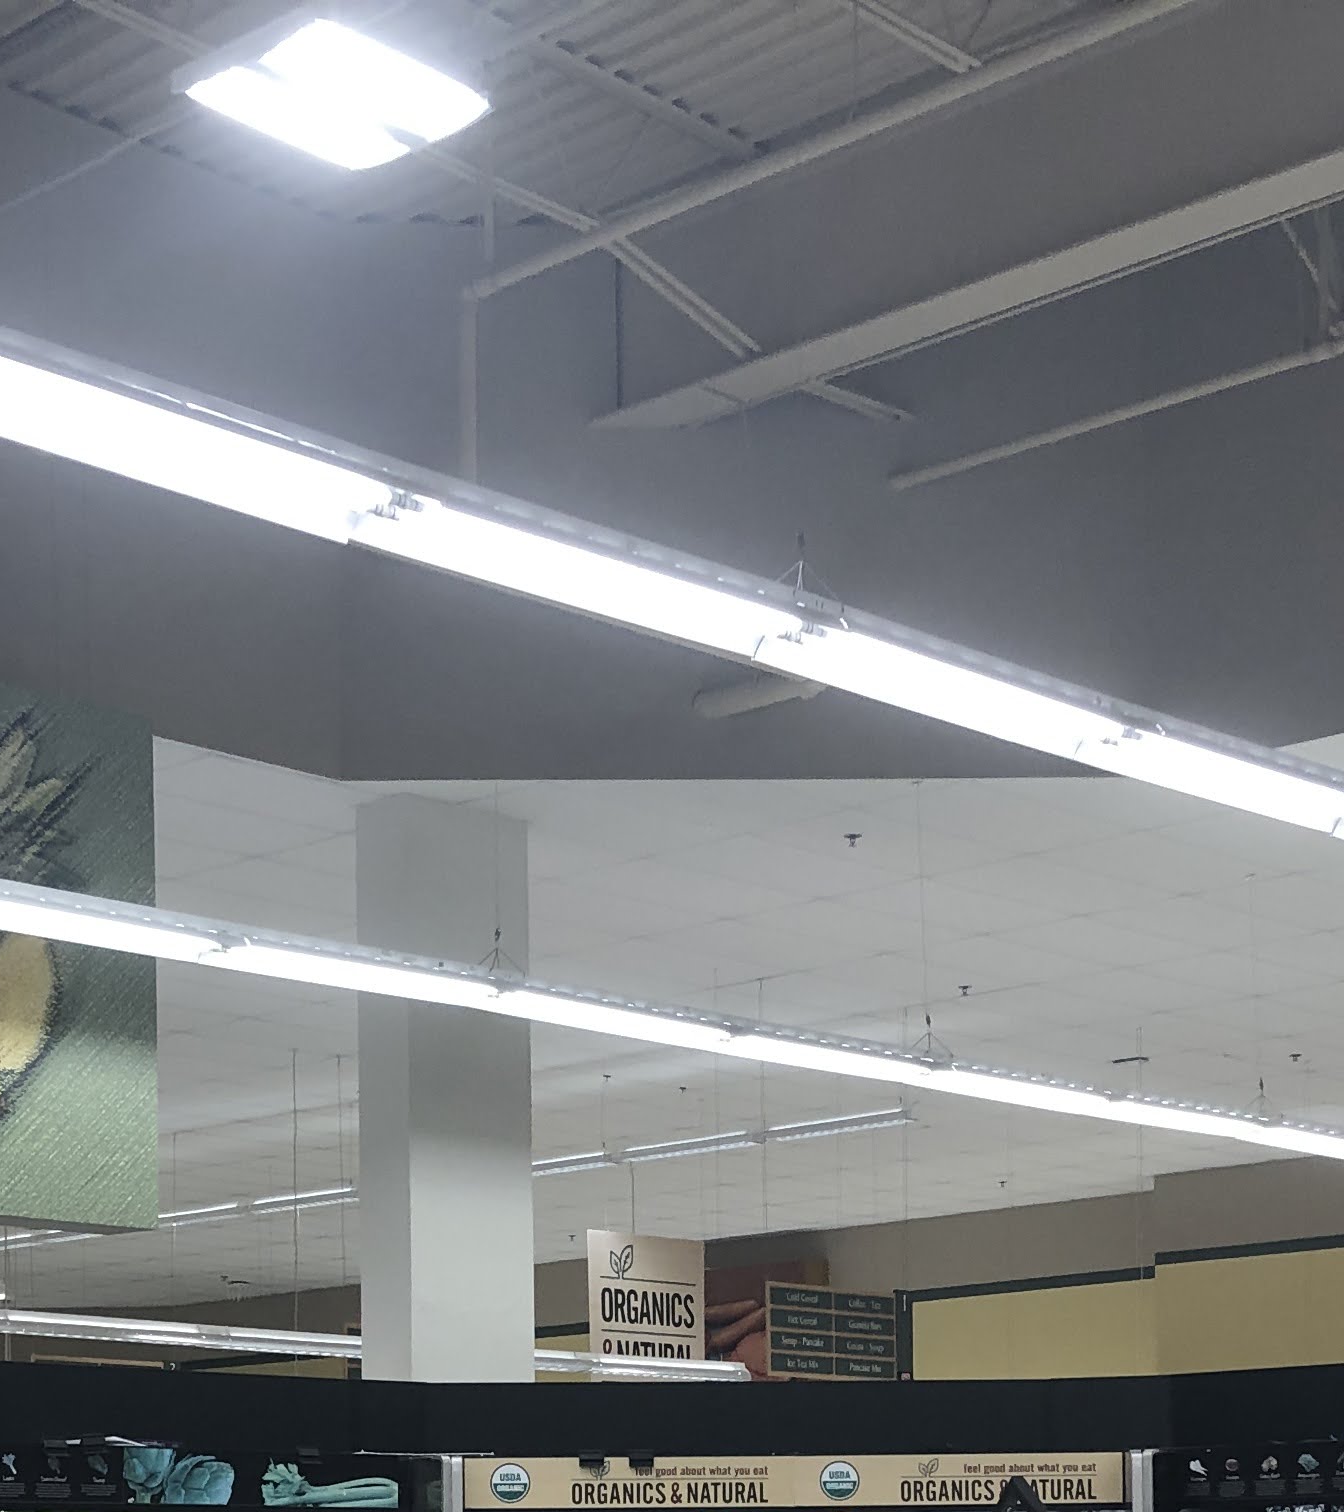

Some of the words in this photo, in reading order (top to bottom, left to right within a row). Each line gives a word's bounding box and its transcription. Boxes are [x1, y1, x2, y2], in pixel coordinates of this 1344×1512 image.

[601, 1287, 695, 1329] ORGANICS
[655, 1466, 678, 1478] good
[680, 1465, 706, 1476] about
[708, 1465, 732, 1476] what
[733, 1467, 751, 1478] you
[752, 1465, 769, 1476] eat
[828, 1471, 851, 1480] USDA
[963, 1463, 981, 1474] feel
[983, 1463, 1006, 1475] good
[1008, 1462, 1035, 1474] about
[1037, 1463, 1060, 1474] what
[1062, 1464, 1079, 1476] you
[1081, 1463, 1097, 1473] eat
[499, 1473, 522, 1483] USDA
[571, 1482, 666, 1505] ORGANICS
[670, 1482, 683, 1504] &
[687, 1481, 769, 1504] NATURAL
[901, 1479, 995, 1502] ORGANICS
[1031, 1478, 1097, 1500] ATURAL
